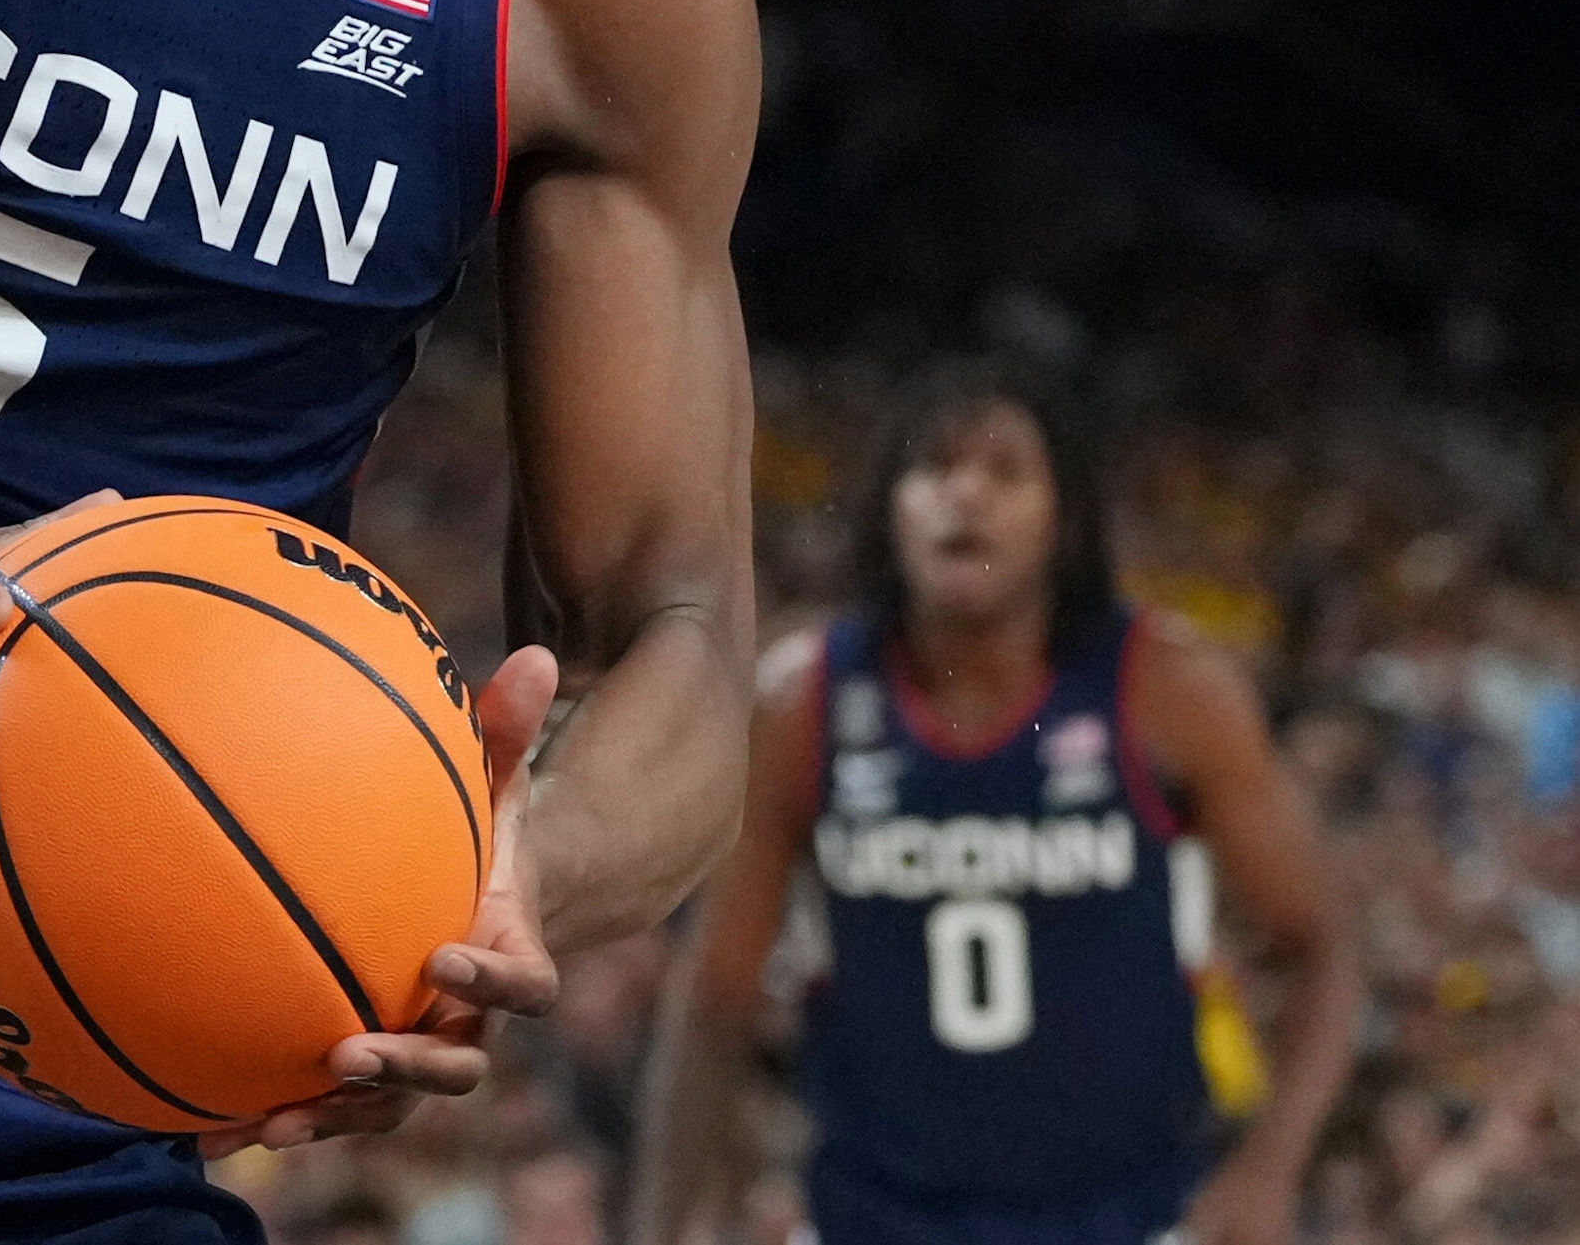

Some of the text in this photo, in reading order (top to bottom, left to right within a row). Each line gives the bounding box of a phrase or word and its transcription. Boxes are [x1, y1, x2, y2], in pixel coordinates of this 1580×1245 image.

[311, 37, 424, 87] EAST
[329, 16, 412, 56] BIG
[815, 811, 1136, 900] UCONN
[926, 899, 1036, 1052] 0
